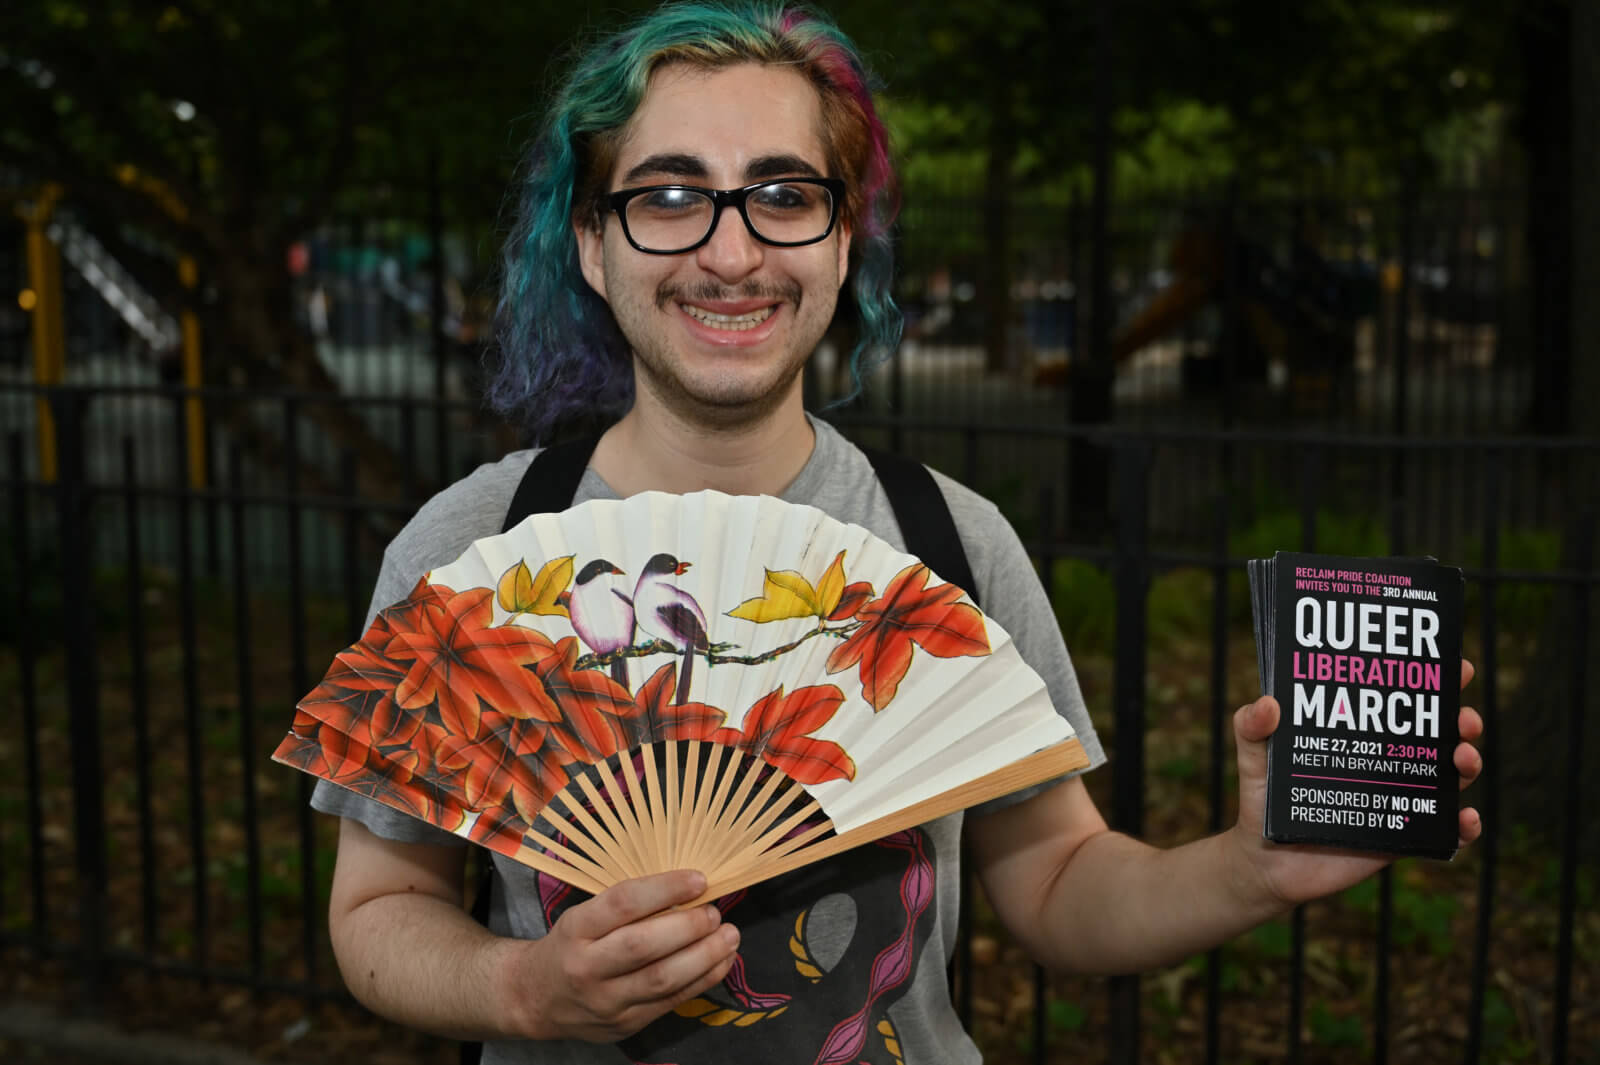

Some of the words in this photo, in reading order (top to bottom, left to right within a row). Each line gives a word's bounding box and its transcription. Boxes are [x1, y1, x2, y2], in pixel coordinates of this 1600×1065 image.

[1296, 568, 1335, 580] RECLAIM
[1337, 570, 1363, 582] PRIDE
[1365, 572, 1411, 586] COALITION
[1296, 580, 1330, 592] INVITES
[1332, 582, 1350, 594] YOU
[1352, 584, 1362, 595] TO
[1365, 585, 1381, 596] THE
[1383, 587, 1401, 598] 3RD
[1403, 589, 1437, 601] ANNUAL
[1295, 597, 1440, 658] QUEER
[1294, 652, 1440, 691] LIBERATION
[1293, 683, 1439, 738] MARCH
[1293, 736, 1328, 750] JUNE
[1352, 741, 1382, 755] 2021
[1387, 743, 1414, 758] 2:30
[1417, 747, 1437, 760] PM
[1293, 754, 1328, 767] MEET
[1331, 756, 1345, 768] IN
[1348, 758, 1400, 774] BRYANT
[1403, 762, 1437, 776] PARK
[1291, 788, 1369, 808] SPONSORED
[1373, 794, 1389, 809] BY
[1392, 796, 1409, 810] NO
[1413, 798, 1436, 814] ONE
[1291, 807, 1365, 826] PRESENTED
[1369, 813, 1384, 827] BY
